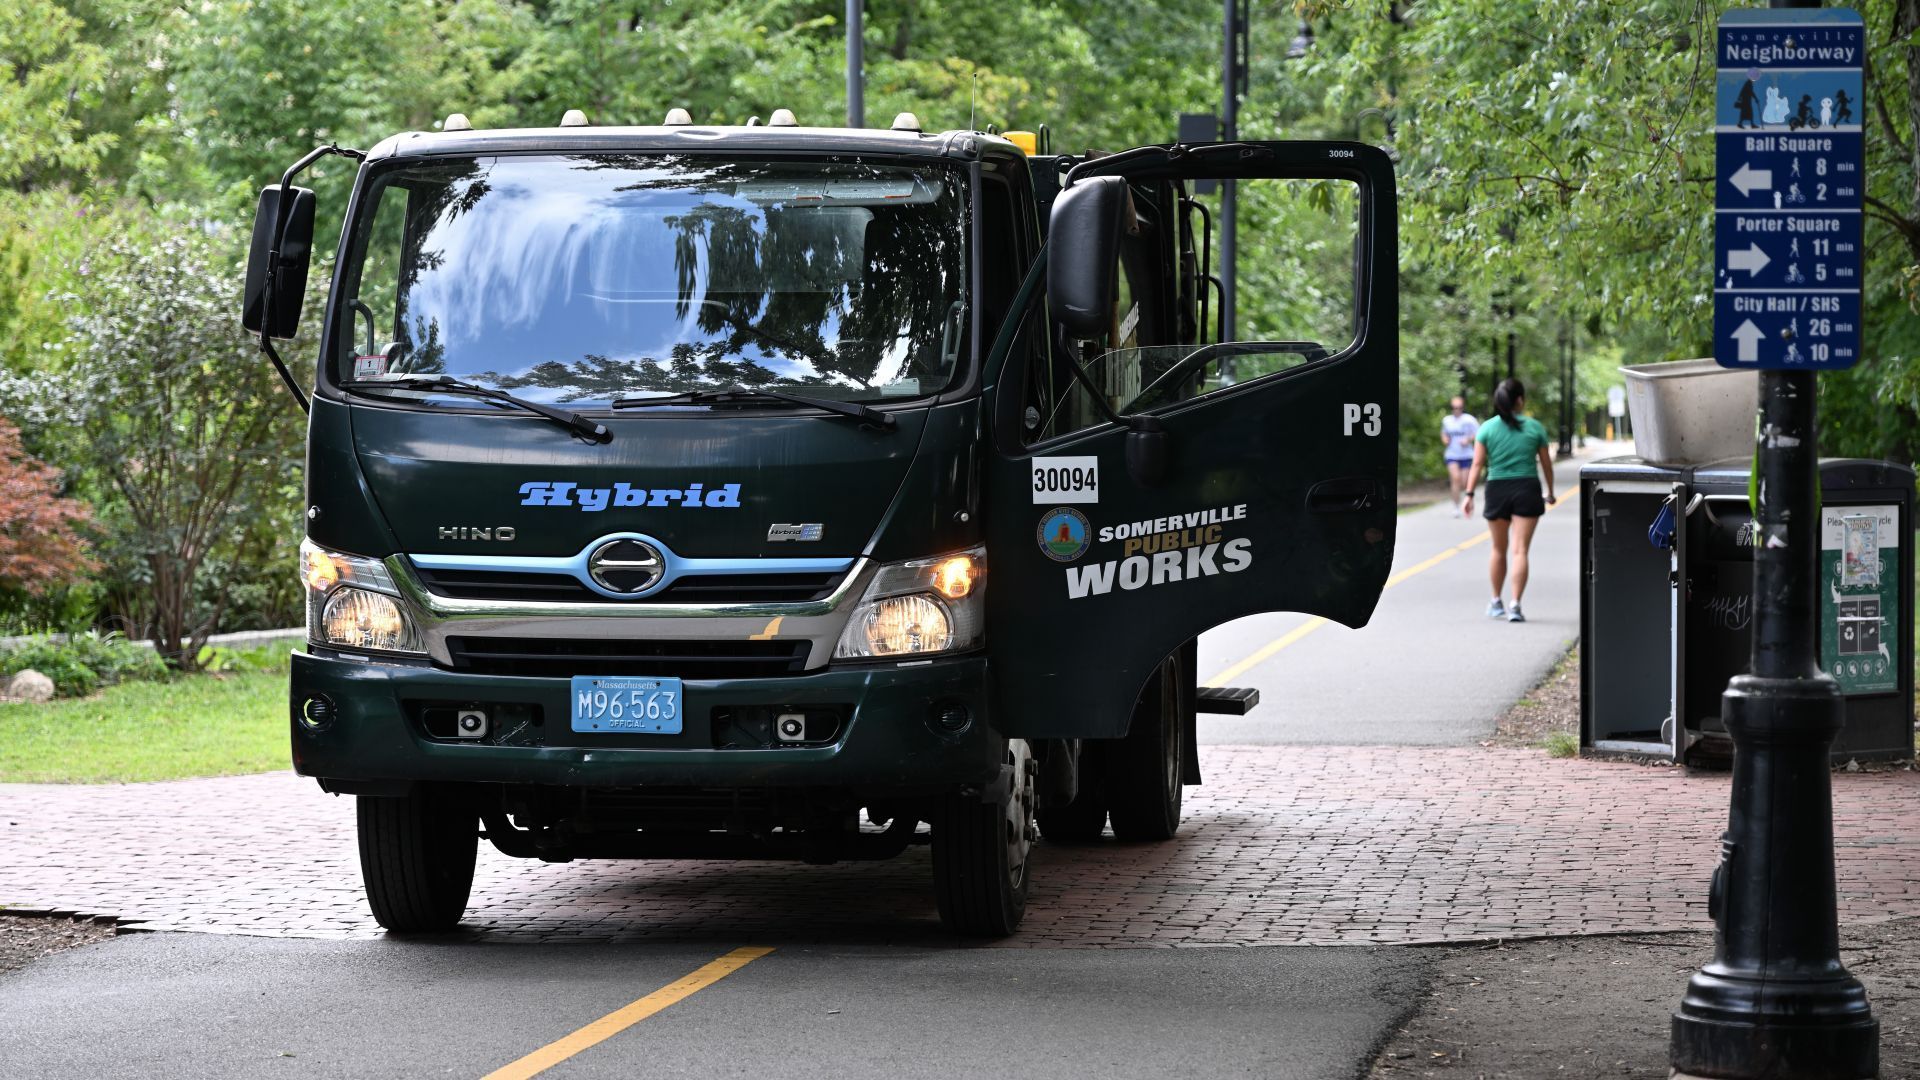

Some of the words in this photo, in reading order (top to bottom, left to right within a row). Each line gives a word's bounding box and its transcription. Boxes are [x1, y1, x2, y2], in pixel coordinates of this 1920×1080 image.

[1726, 32, 1855, 42] Somerville
[1726, 44, 1855, 63] Neighborway
[1745, 136, 1775, 151] Ball
[1779, 136, 1832, 153] Square
[1328, 150, 1354, 158] 30094
[1816, 158, 1827, 176] 8
[1837, 162, 1855, 171] min
[1816, 183, 1827, 201] 2
[1836, 186, 1854, 196] min
[1736, 217, 1783, 232] Porter
[1786, 216, 1840, 233] Square
[1813, 238, 1829, 256] 11
[1836, 242, 1853, 252] min
[1816, 263, 1827, 281] 5
[1836, 267, 1853, 277] min
[1734, 297, 1763, 313] City
[1767, 297, 1796, 312] Hall
[1800, 297, 1807, 312] /
[1811, 297, 1840, 312] SHS
[1809, 318, 1831, 336] 26
[1835, 322, 1853, 332] min
[1810, 343, 1829, 362] 10
[1835, 348, 1852, 357] min
[1343, 402, 1382, 437] P3
[1034, 467, 1096, 492] 30094
[518, 482, 742, 512] Hybrid
[1098, 503, 1247, 543] SOMERVILLE
[438, 526, 516, 541] HINO
[1124, 524, 1222, 558] PUBLIC
[1065, 537, 1252, 600] WORKS
[596, 680, 657, 690] Massachusetts
[608, 720, 645, 728] OFFICIAL
